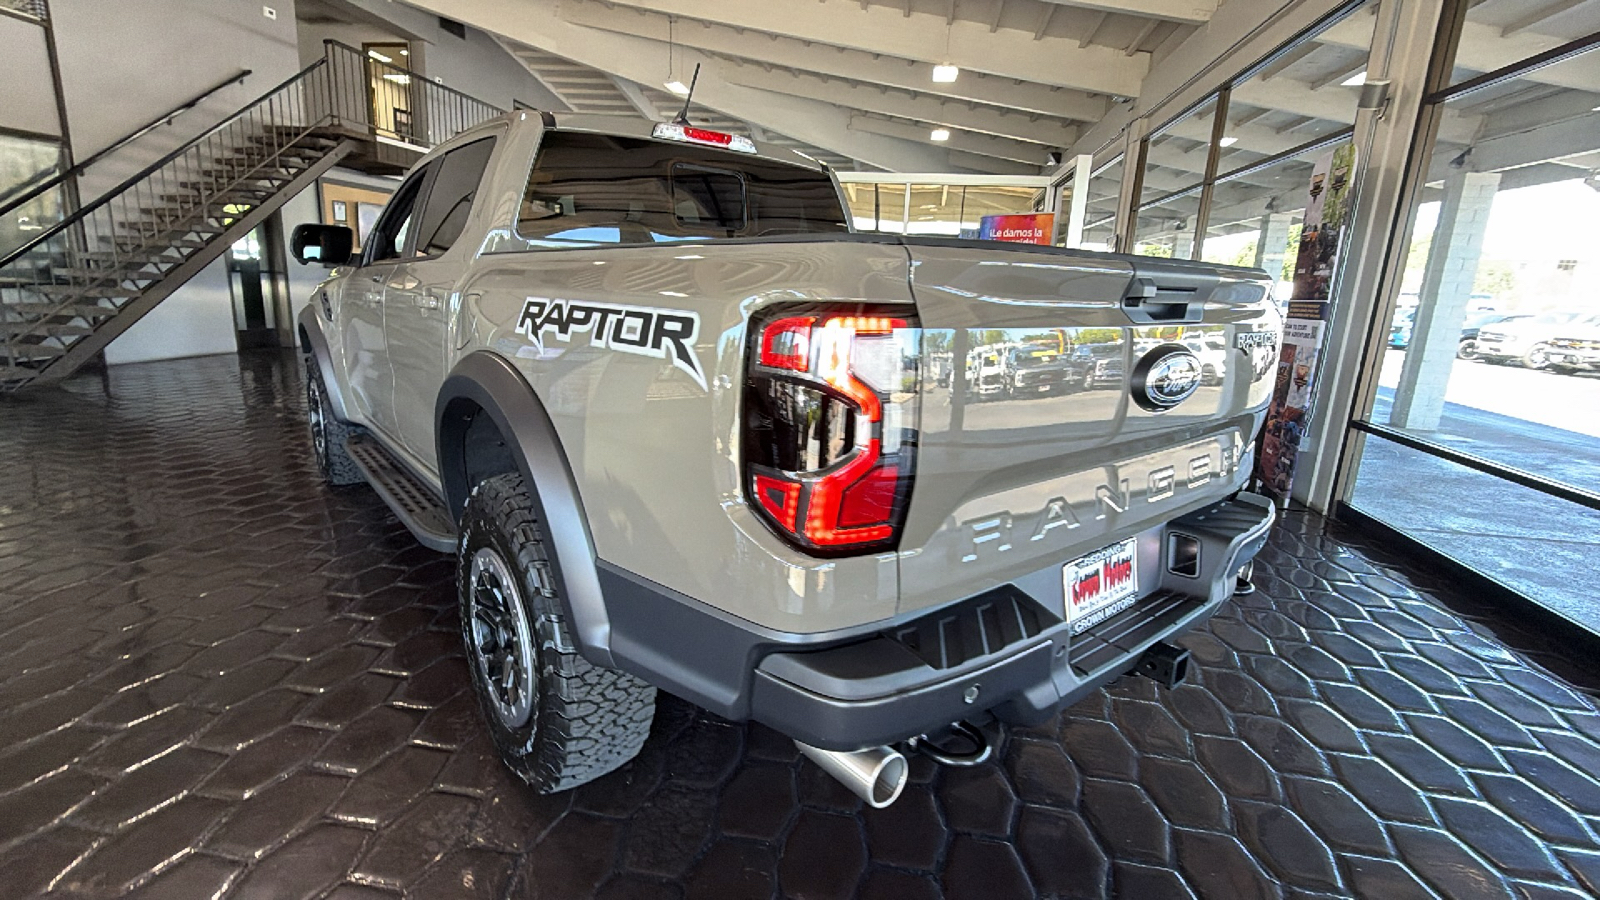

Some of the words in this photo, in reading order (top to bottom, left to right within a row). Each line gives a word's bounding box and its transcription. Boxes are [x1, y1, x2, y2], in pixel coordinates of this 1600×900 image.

[1003, 228, 1032, 237] damos
[1034, 228, 1042, 237] la
[515, 297, 709, 392] RAPTOR
[961, 446, 1240, 562] RANGER
[1074, 609, 1105, 633] CROWN
[1104, 595, 1136, 619] MOTORS
